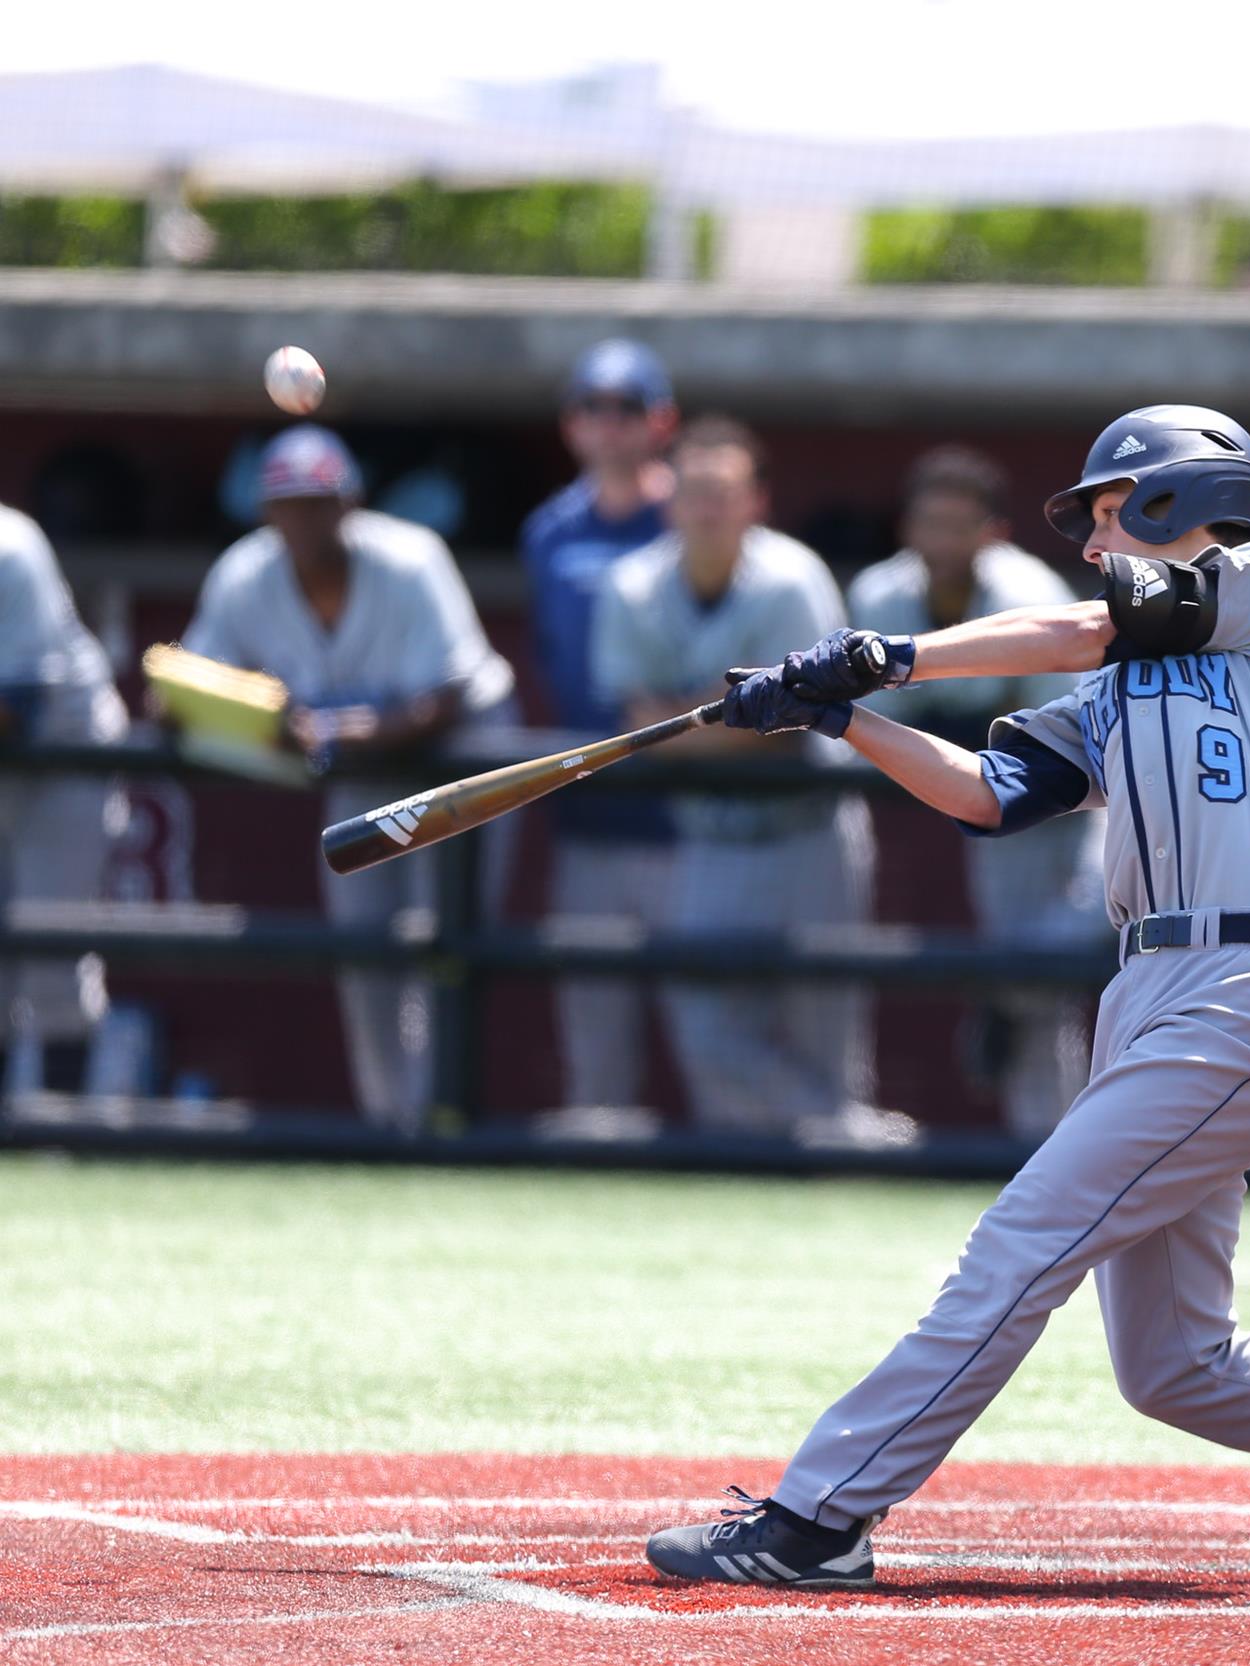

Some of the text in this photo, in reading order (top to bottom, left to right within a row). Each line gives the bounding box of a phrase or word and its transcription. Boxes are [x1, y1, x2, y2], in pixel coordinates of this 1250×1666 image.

[1113, 443, 1147, 460] adidas
[1197, 723, 1248, 804] 9
[365, 789, 437, 822] adidas
